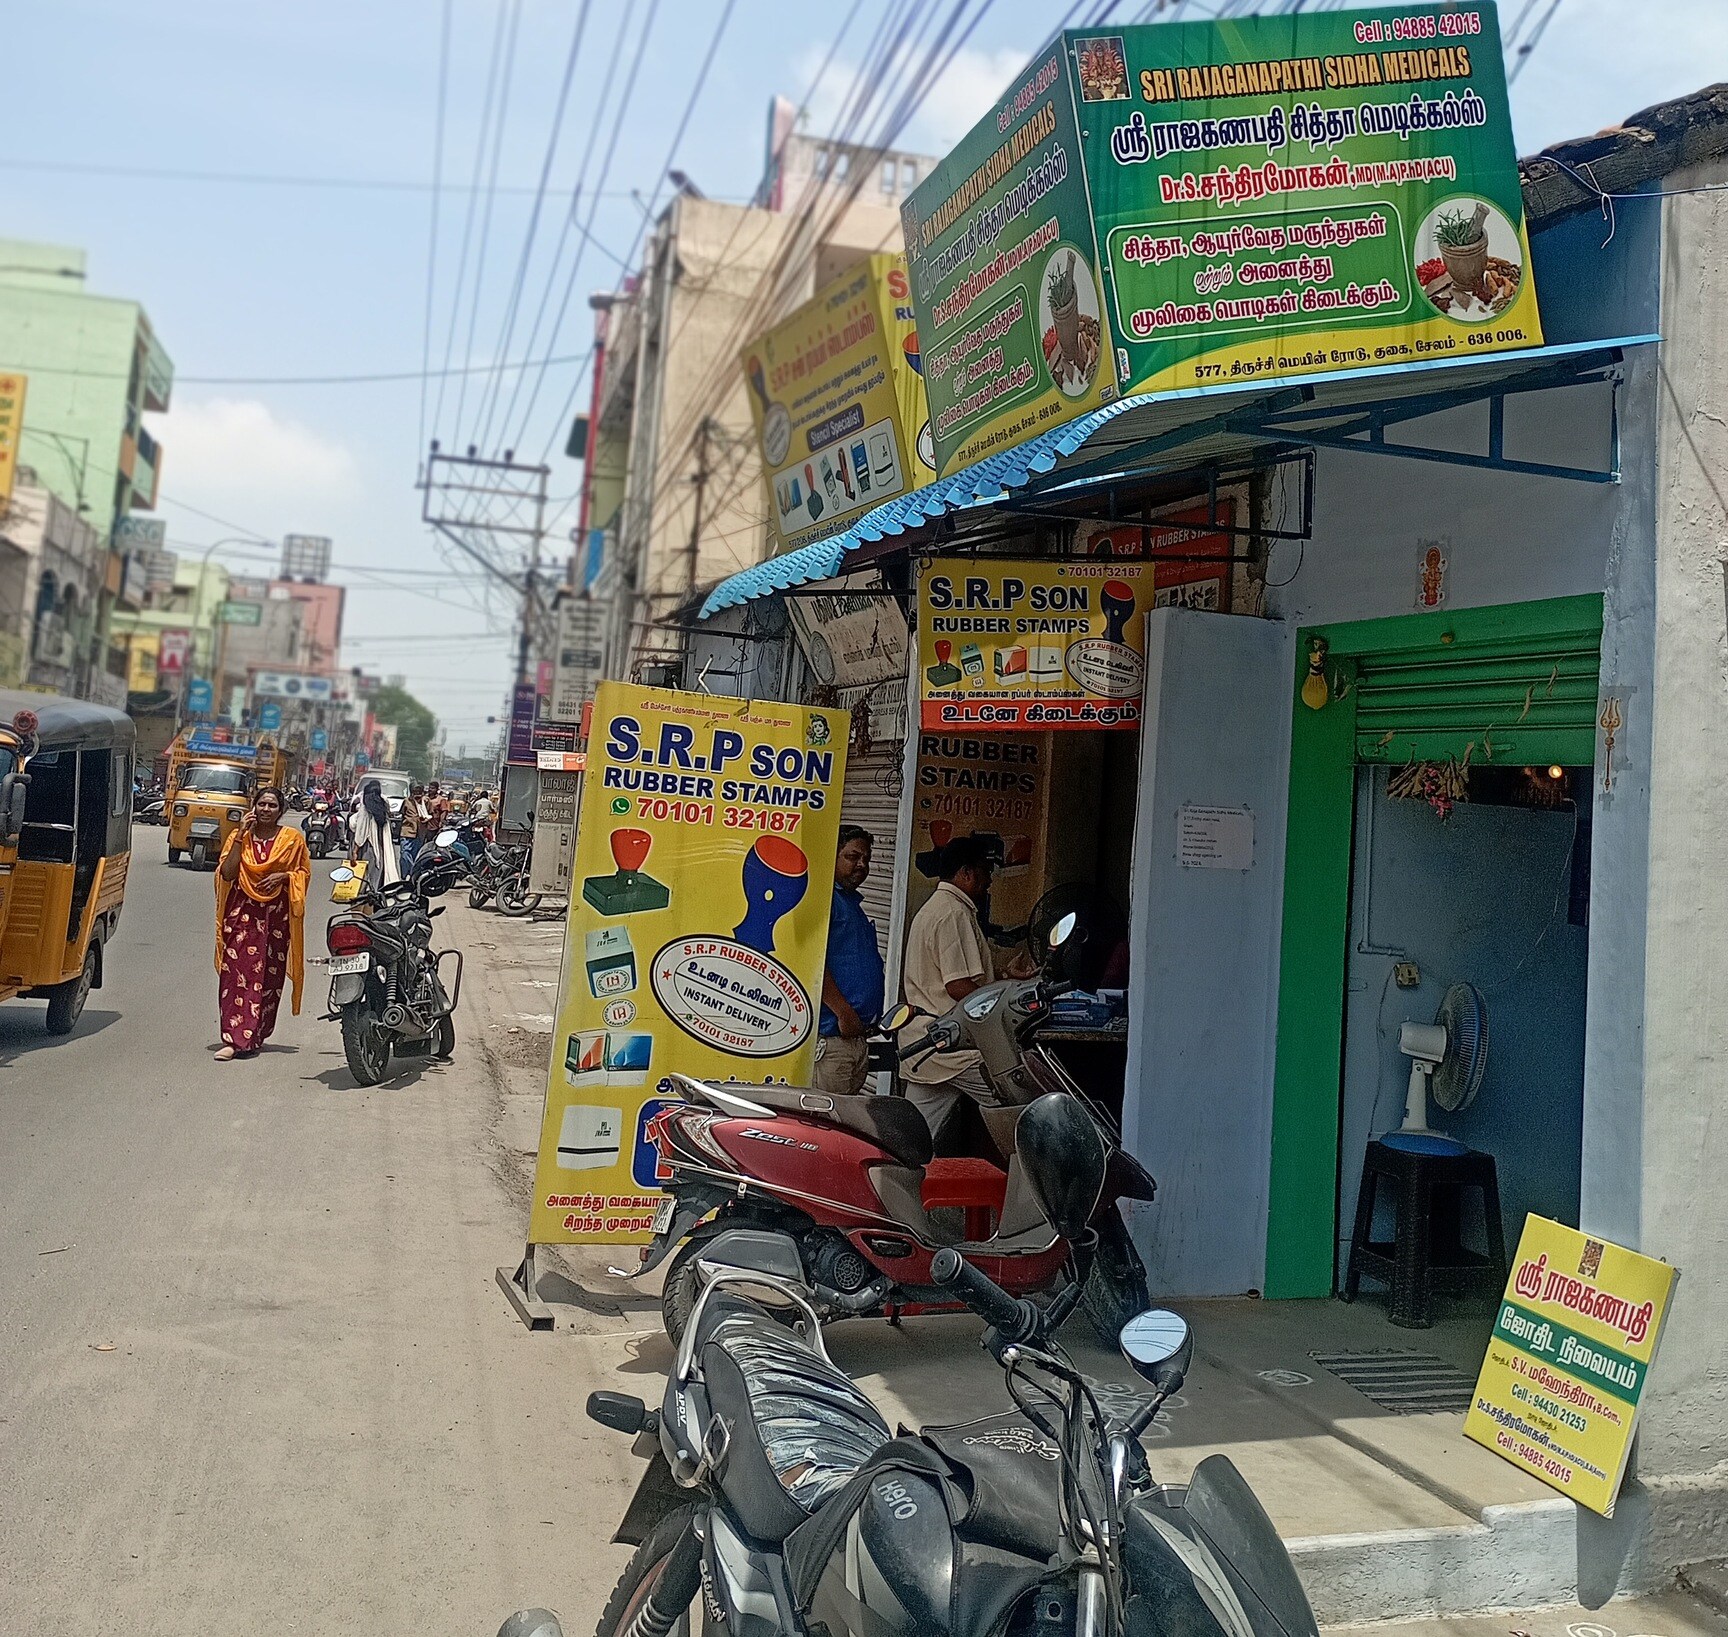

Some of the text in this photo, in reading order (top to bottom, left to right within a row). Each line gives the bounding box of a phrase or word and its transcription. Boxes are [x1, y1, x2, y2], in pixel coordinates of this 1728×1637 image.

[1354, 20, 1385, 43] Cell
[1393, 15, 1436, 39] 94885
[1438, 12, 1481, 35] 42015
[1140, 46, 1470, 103] SRI RAJAGANAPATHI SIDHA MEDICALS
[986, 142, 1012, 189] SIDHA
[1012, 100, 1056, 164] MEDICALS
[1153, 103, 1288, 160] ராஜகணபதி
[1289, 99, 1356, 155] சித்தா
[1360, 90, 1487, 140] மெடிக்கல்ஸ்
[1122, 213, 1387, 264] சித்தா, ஆயுர்வேத மருந்துகள்
[1237, 256, 1333, 287] அனைத்து
[1131, 301, 1215, 336] மூலிகை
[1216, 292, 1299, 321] பொடிகள்
[1194, 361, 1228, 379] 577,
[1277, 347, 1330, 372] மெயின்
[1414, 332, 1456, 354] சேலம்
[1467, 332, 1494, 345] 636
[829, 409, 862, 440] Specialist
[1157, 529, 1189, 548] RUBBER
[1068, 566, 1142, 578] 70101 32187
[929, 576, 1025, 612] S.R.P
[1030, 586, 1089, 612] SON
[932, 617, 1090, 634] RUBBER STAMPS
[941, 705, 1018, 723] உடனே
[605, 716, 745, 775] S.R.P
[750, 743, 834, 786] SON
[921, 736, 1039, 764] RUBBER
[604, 766, 825, 810] RUBBER STAMPS
[920, 765, 1036, 794] STAMPS
[637, 797, 802, 834] 70101 32187
[934, 794, 1033, 820] 70101 32187
[684, 944, 805, 1013] S.R.P RUBBER STAMPS
[687, 961, 783, 1011] உடனடி டெலிவரி
[683, 986, 771, 1032] INSTANT DELIVERY
[693, 1017, 754, 1047] 70101 32187
[738, 1127, 799, 1146] Zest
[546, 1195, 606, 1213] அனைத்து
[563, 1214, 604, 1233] சிறந்த
[1541, 1269, 1654, 1347] ராஜகணபதி
[1500, 1306, 1638, 1391] ஜோதிட நிலையம்
[1511, 1383, 1529, 1402] Cell
[1533, 1394, 1559, 1418] 94430
[1559, 1408, 1587, 1432] 21253
[1497, 1432, 1513, 1450] Cell
[1518, 1443, 1544, 1467] 94885
[1545, 1458, 1572, 1484] 42015
[876, 1480, 919, 1521] Hero
